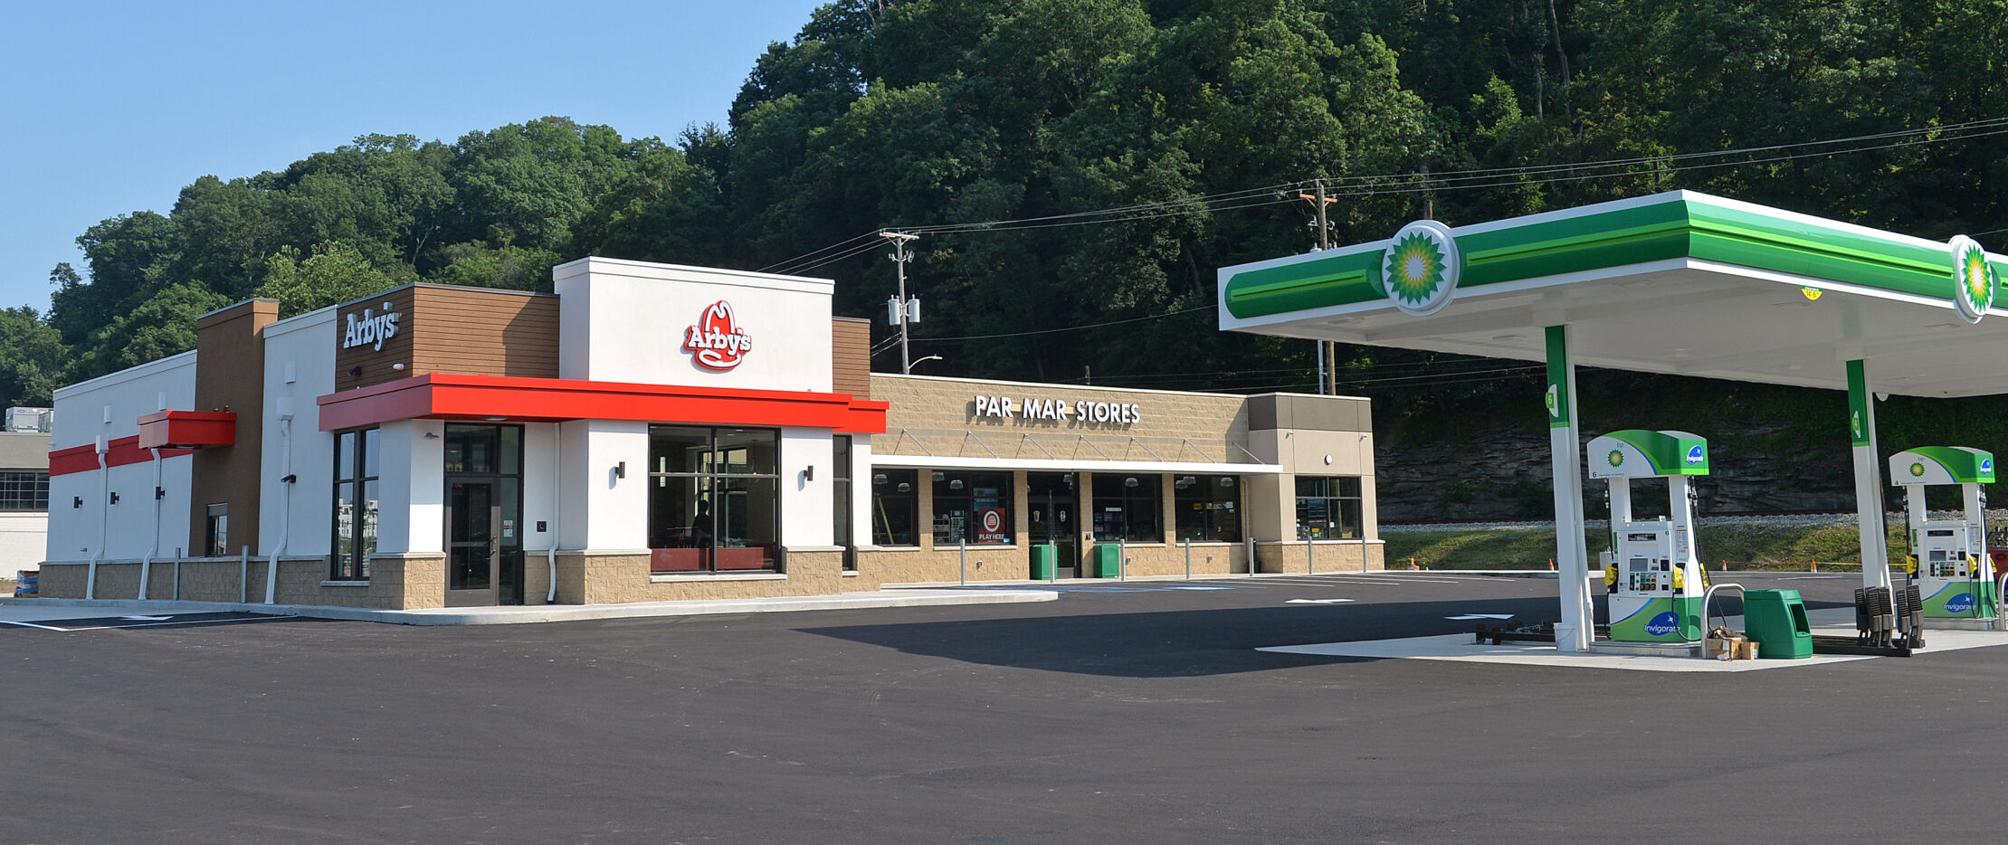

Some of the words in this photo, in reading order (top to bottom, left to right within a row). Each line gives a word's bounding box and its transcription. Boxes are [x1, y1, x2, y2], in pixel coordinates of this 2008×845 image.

[343, 301, 399, 352] Arby's
[688, 326, 751, 356] Arby's
[975, 395, 1013, 417] PAR
[1023, 397, 1067, 420] MAR
[1076, 401, 1140, 424] STORES
